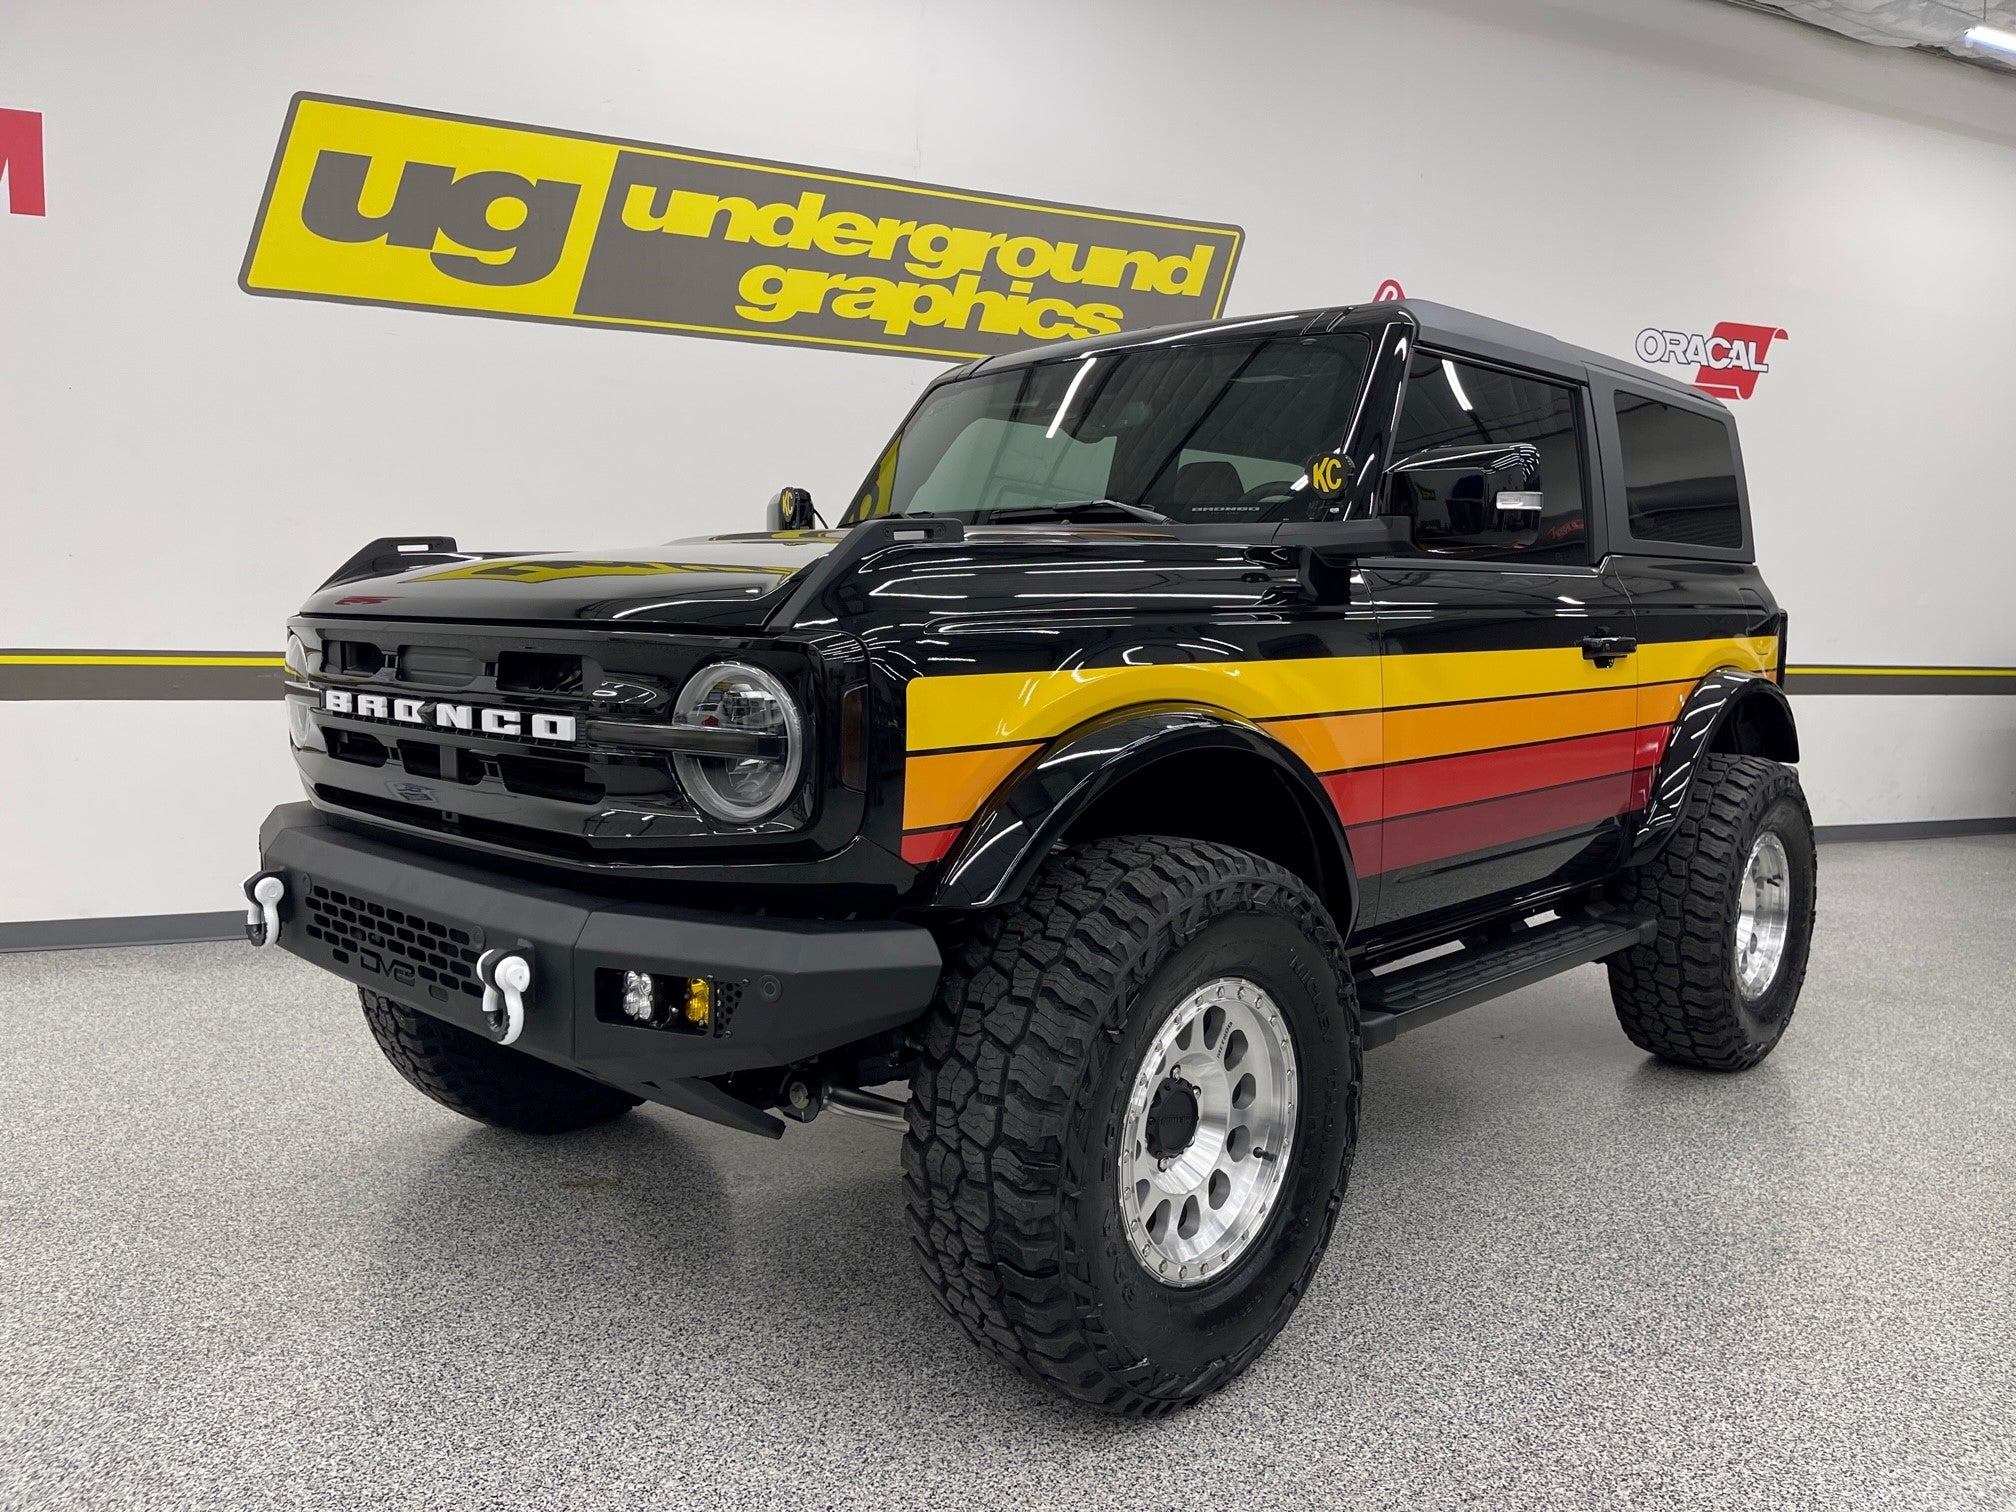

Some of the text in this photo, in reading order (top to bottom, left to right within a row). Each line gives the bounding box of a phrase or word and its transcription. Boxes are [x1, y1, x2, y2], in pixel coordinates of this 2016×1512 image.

[301, 149, 582, 286] ug
[621, 183, 1215, 297] underground
[735, 264, 1122, 340] graphics
[1635, 328, 1769, 373] ORACAL
[1313, 457, 1342, 493] KC
[325, 689, 577, 742] BRONCO
